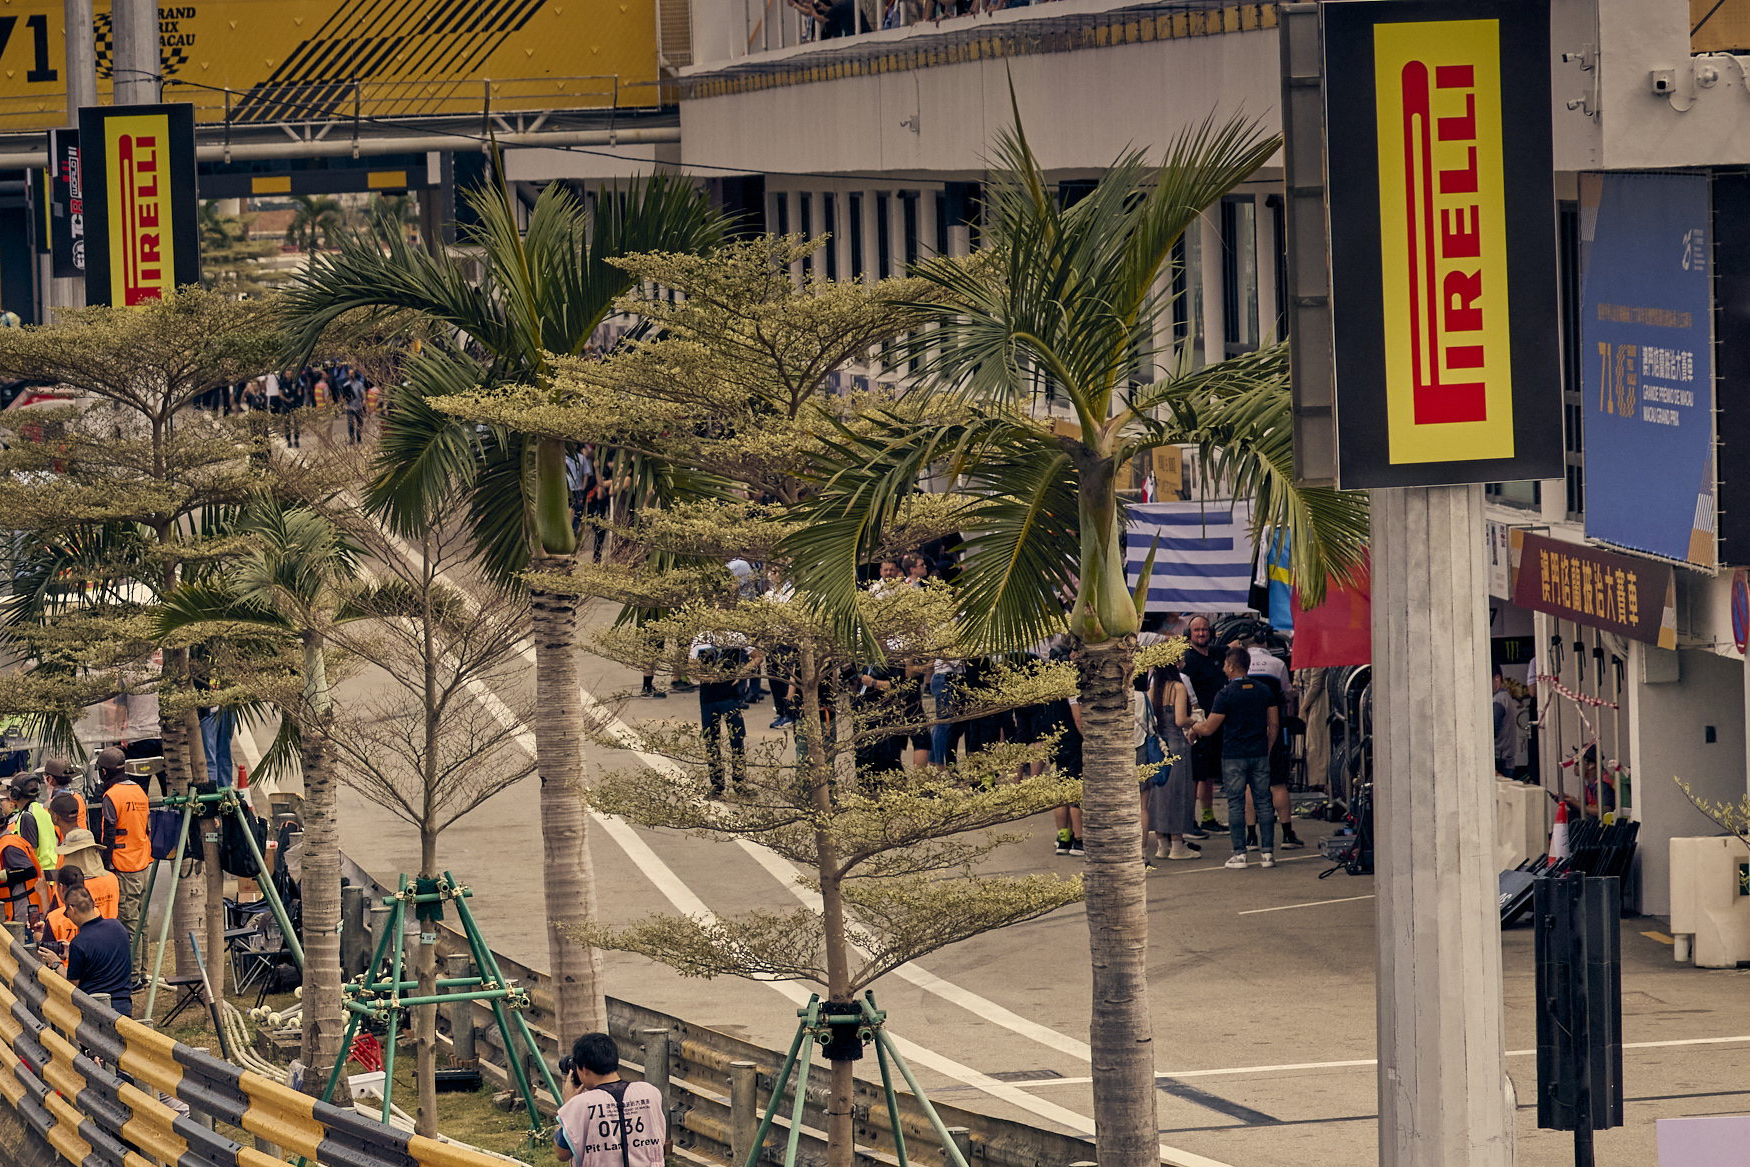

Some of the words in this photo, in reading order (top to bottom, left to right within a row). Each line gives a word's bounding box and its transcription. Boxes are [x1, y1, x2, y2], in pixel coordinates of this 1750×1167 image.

[158, 7, 196, 19] RAND
[158, 21, 178, 33] RIX
[159, 33, 196, 47] ACAU
[119, 134, 162, 306] PIRELLI
[1402, 60, 1487, 426] PIRELLI
[1598, 342, 1614, 414] 71
[1540, 549, 1639, 627] 澳門格蘭披治大賽車
[125, 801, 136, 812] 71
[65, 928, 77, 939] 71
[588, 1103, 605, 1120] 71
[598, 1116, 644, 1138] 0736
[585, 1144, 600, 1153] Pit
[604, 1142, 628, 1151] Lan
[632, 1138, 660, 1147] Crew
